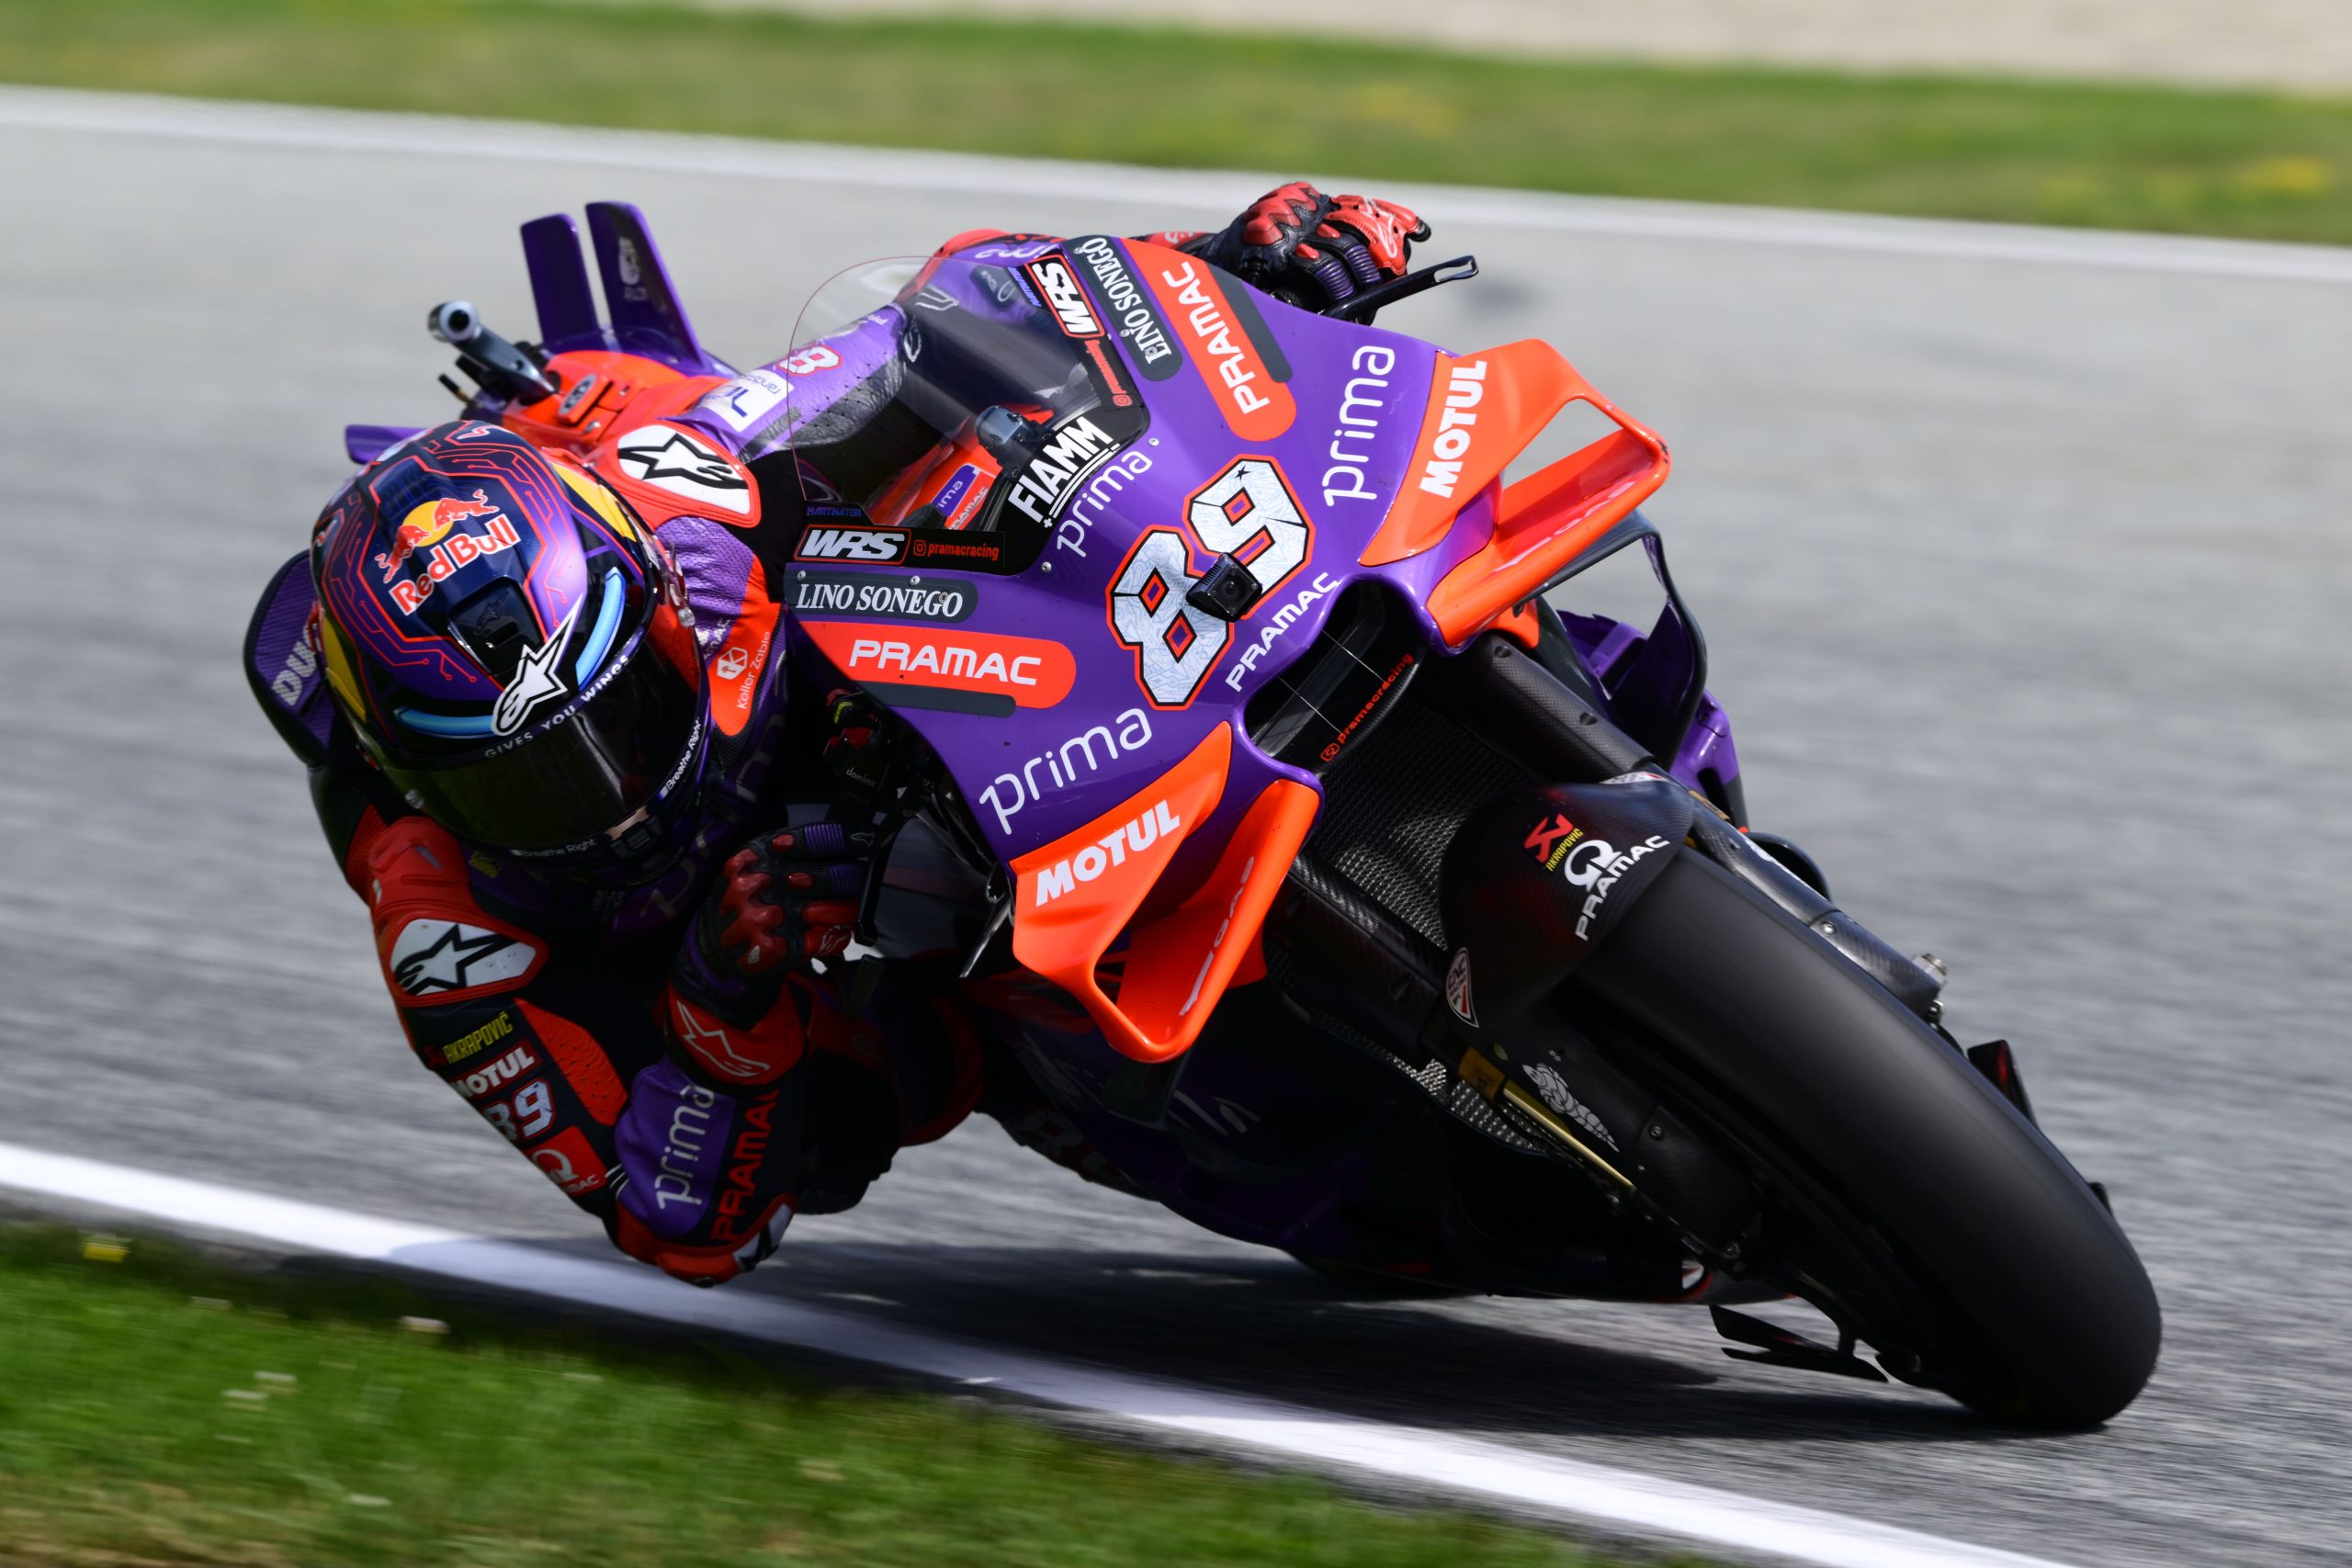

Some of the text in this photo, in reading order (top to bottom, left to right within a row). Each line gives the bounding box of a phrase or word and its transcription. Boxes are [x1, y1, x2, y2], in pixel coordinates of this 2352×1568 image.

[1032, 263, 1098, 333] WRS
[1082, 237, 1171, 364] LINO SONEGO
[1163, 262, 1270, 415] PRAMAC
[1009, 416, 1114, 524] FIAMM
[1324, 344, 1396, 506] prima
[1419, 360, 1487, 499] MOTUL
[801, 530, 905, 559] WRS
[1057, 451, 1153, 558] prima
[389, 513, 521, 615] Red Bull
[796, 583, 963, 618] LINO SONEGO
[1110, 457, 1312, 706] 89
[849, 639, 1041, 685] PRAMAC
[1225, 572, 1340, 692] PRAMAC
[485, 654, 629, 759] GIVES YOU WINGS
[666, 750, 692, 790] Breathe
[979, 707, 1152, 835] prima
[1035, 799, 1181, 908] MOTUL
[1575, 834, 1671, 942] PRAMAC
[653, 1084, 716, 1211] prima
